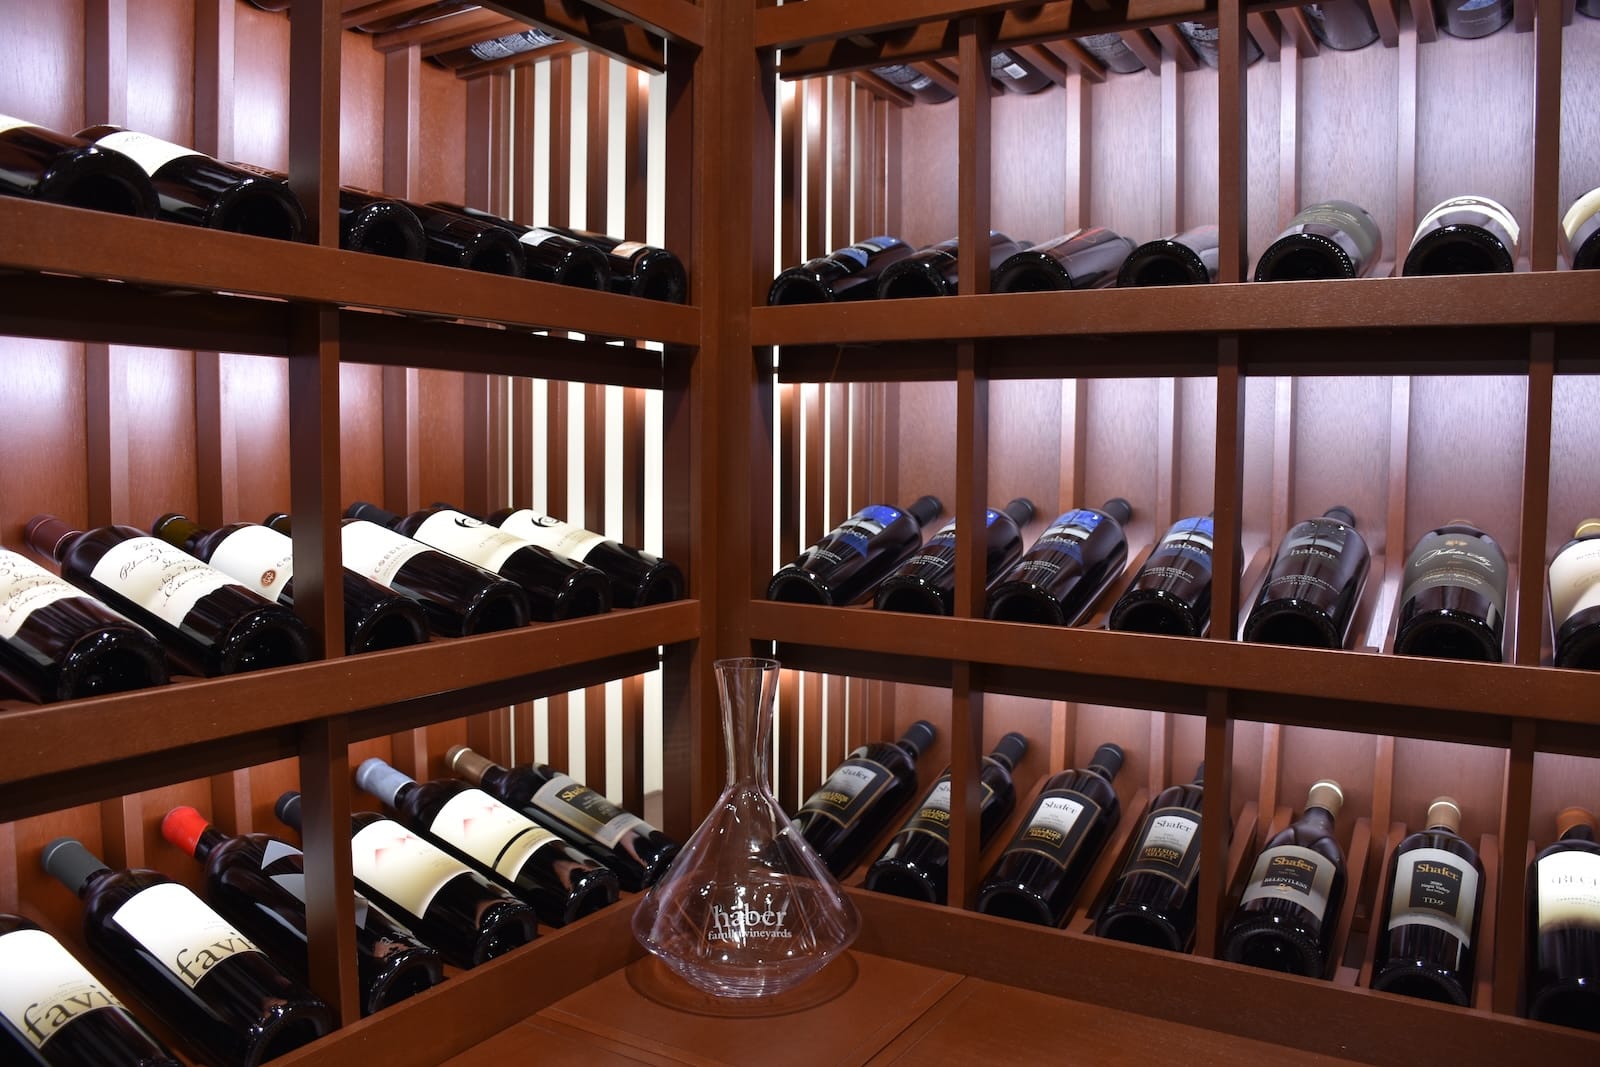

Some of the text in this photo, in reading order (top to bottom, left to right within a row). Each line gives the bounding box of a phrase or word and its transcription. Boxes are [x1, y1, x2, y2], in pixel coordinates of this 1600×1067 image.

[1165, 542, 1207, 554] haber
[1290, 547, 1336, 560] haber
[1045, 802, 1077, 814] Shafer
[1156, 820, 1192, 832] Shafer
[1145, 847, 1180, 857] HILLSIDE
[1272, 857, 1314, 872] Shafer
[1416, 863, 1459, 881] Shafer
[712, 902, 787, 929] haber
[175, 931, 261, 986] favi
[23, 984, 121, 1041] favi
